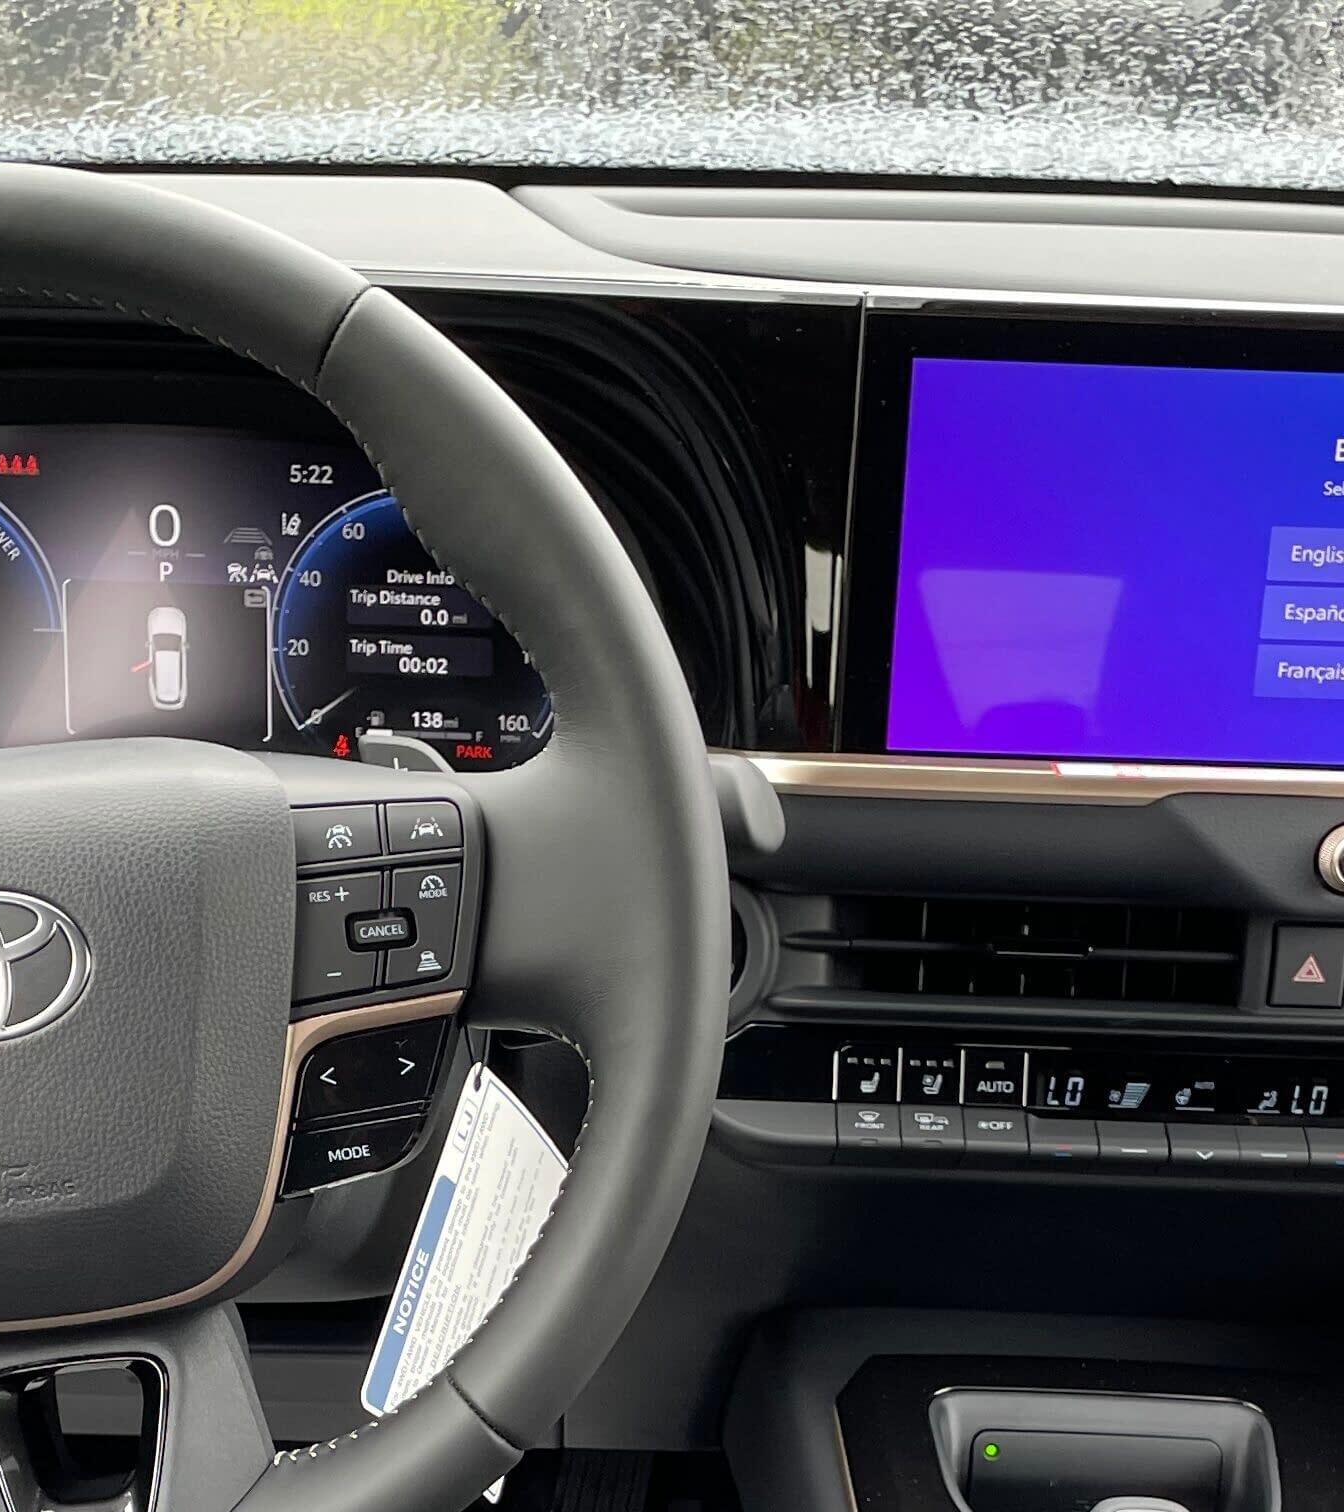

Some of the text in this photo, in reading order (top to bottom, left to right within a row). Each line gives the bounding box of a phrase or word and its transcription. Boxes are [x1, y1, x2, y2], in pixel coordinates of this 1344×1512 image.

[288, 465, 334, 485] 5:22
[149, 504, 181, 547] 0
[342, 522, 366, 541] 60
[160, 561, 174, 582] P
[299, 570, 322, 588] 40
[387, 569, 455, 585] Drive Info
[350, 589, 441, 606] Trip Distance
[420, 609, 449, 626] 0.0
[287, 639, 310, 657] 20
[349, 639, 413, 656] Trip Time
[399, 657, 448, 675] 00:02
[412, 711, 443, 728] 138
[498, 715, 529, 732] 160
[475, 731, 484, 742] F
[456, 745, 493, 759] PARK
[309, 891, 331, 902] RES
[419, 887, 448, 900] MODE
[359, 924, 406, 939] CANCEL
[977, 1080, 1015, 1094] AUTO
[989, 1120, 1015, 1131] OFF
[327, 1144, 372, 1163] MODE
[392, 1247, 431, 1336] NOTICE
